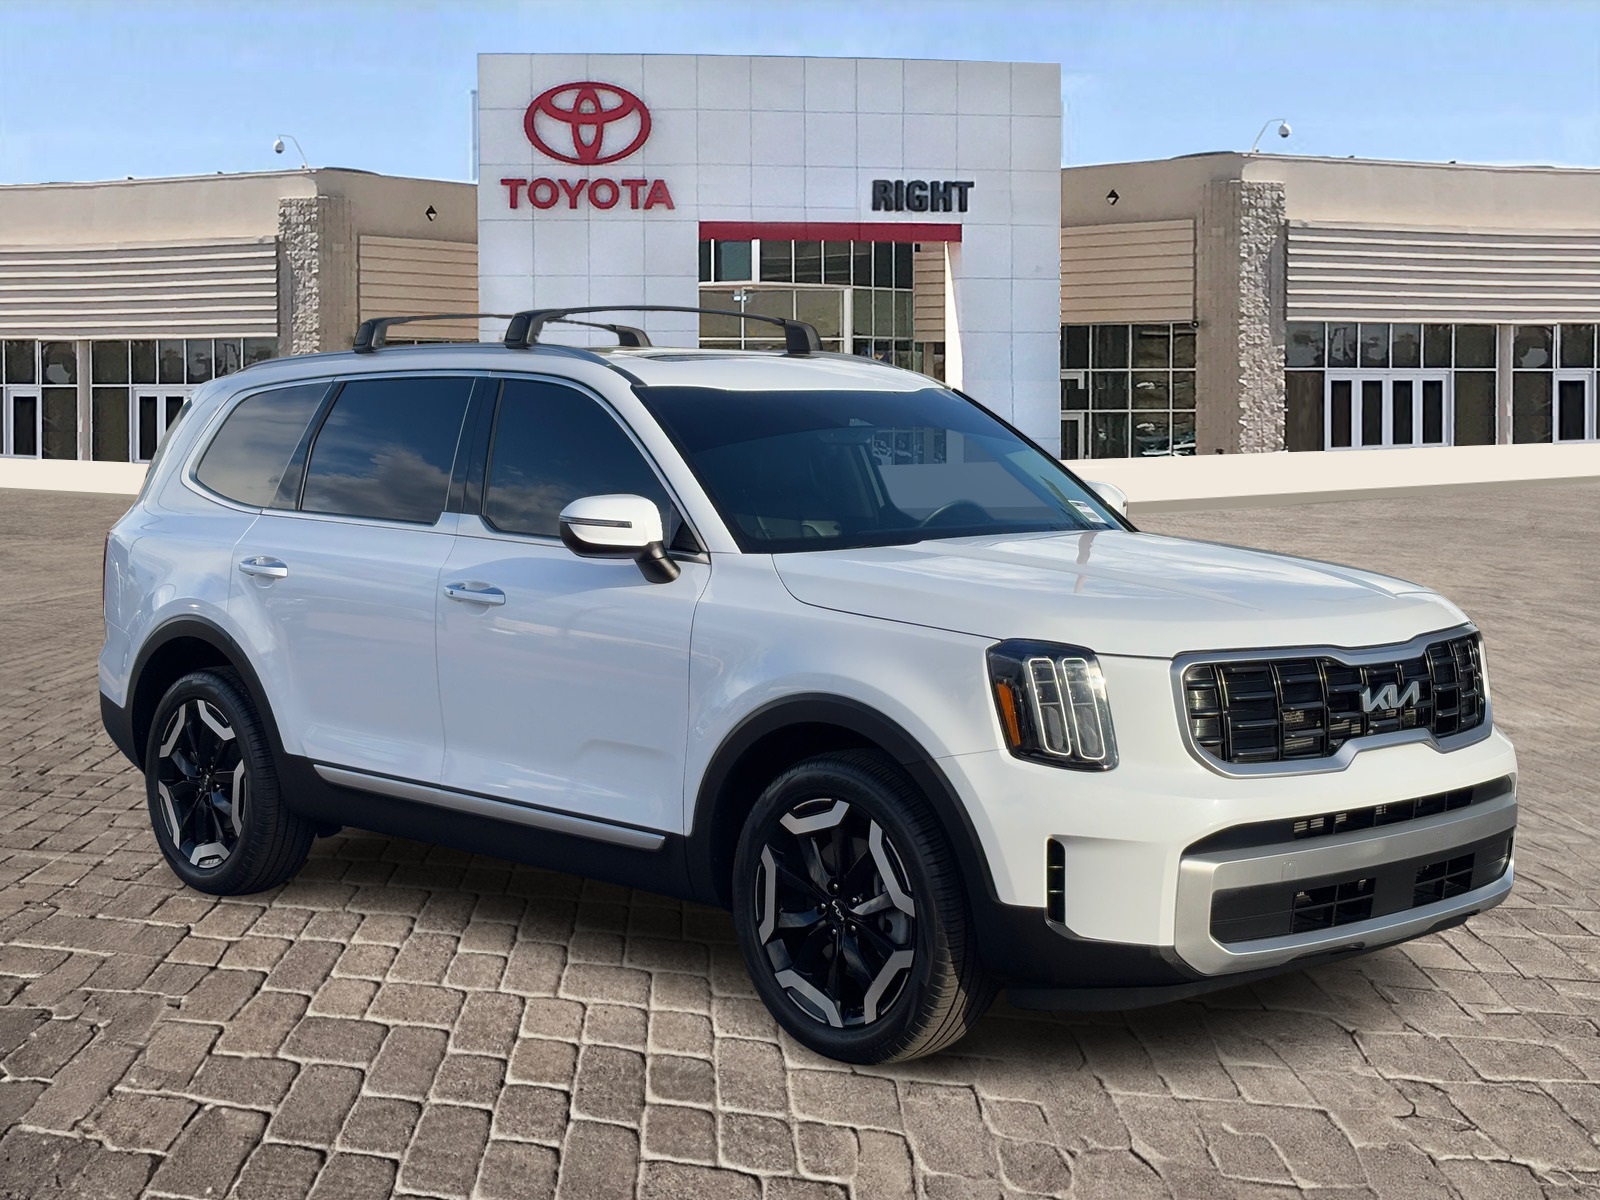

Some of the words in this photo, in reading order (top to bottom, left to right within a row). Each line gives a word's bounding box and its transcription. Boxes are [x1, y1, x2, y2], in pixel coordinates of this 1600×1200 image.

[500, 177, 675, 210] TOYOTA
[872, 179, 975, 212] RIGHT
[1362, 681, 1420, 712] KIA
